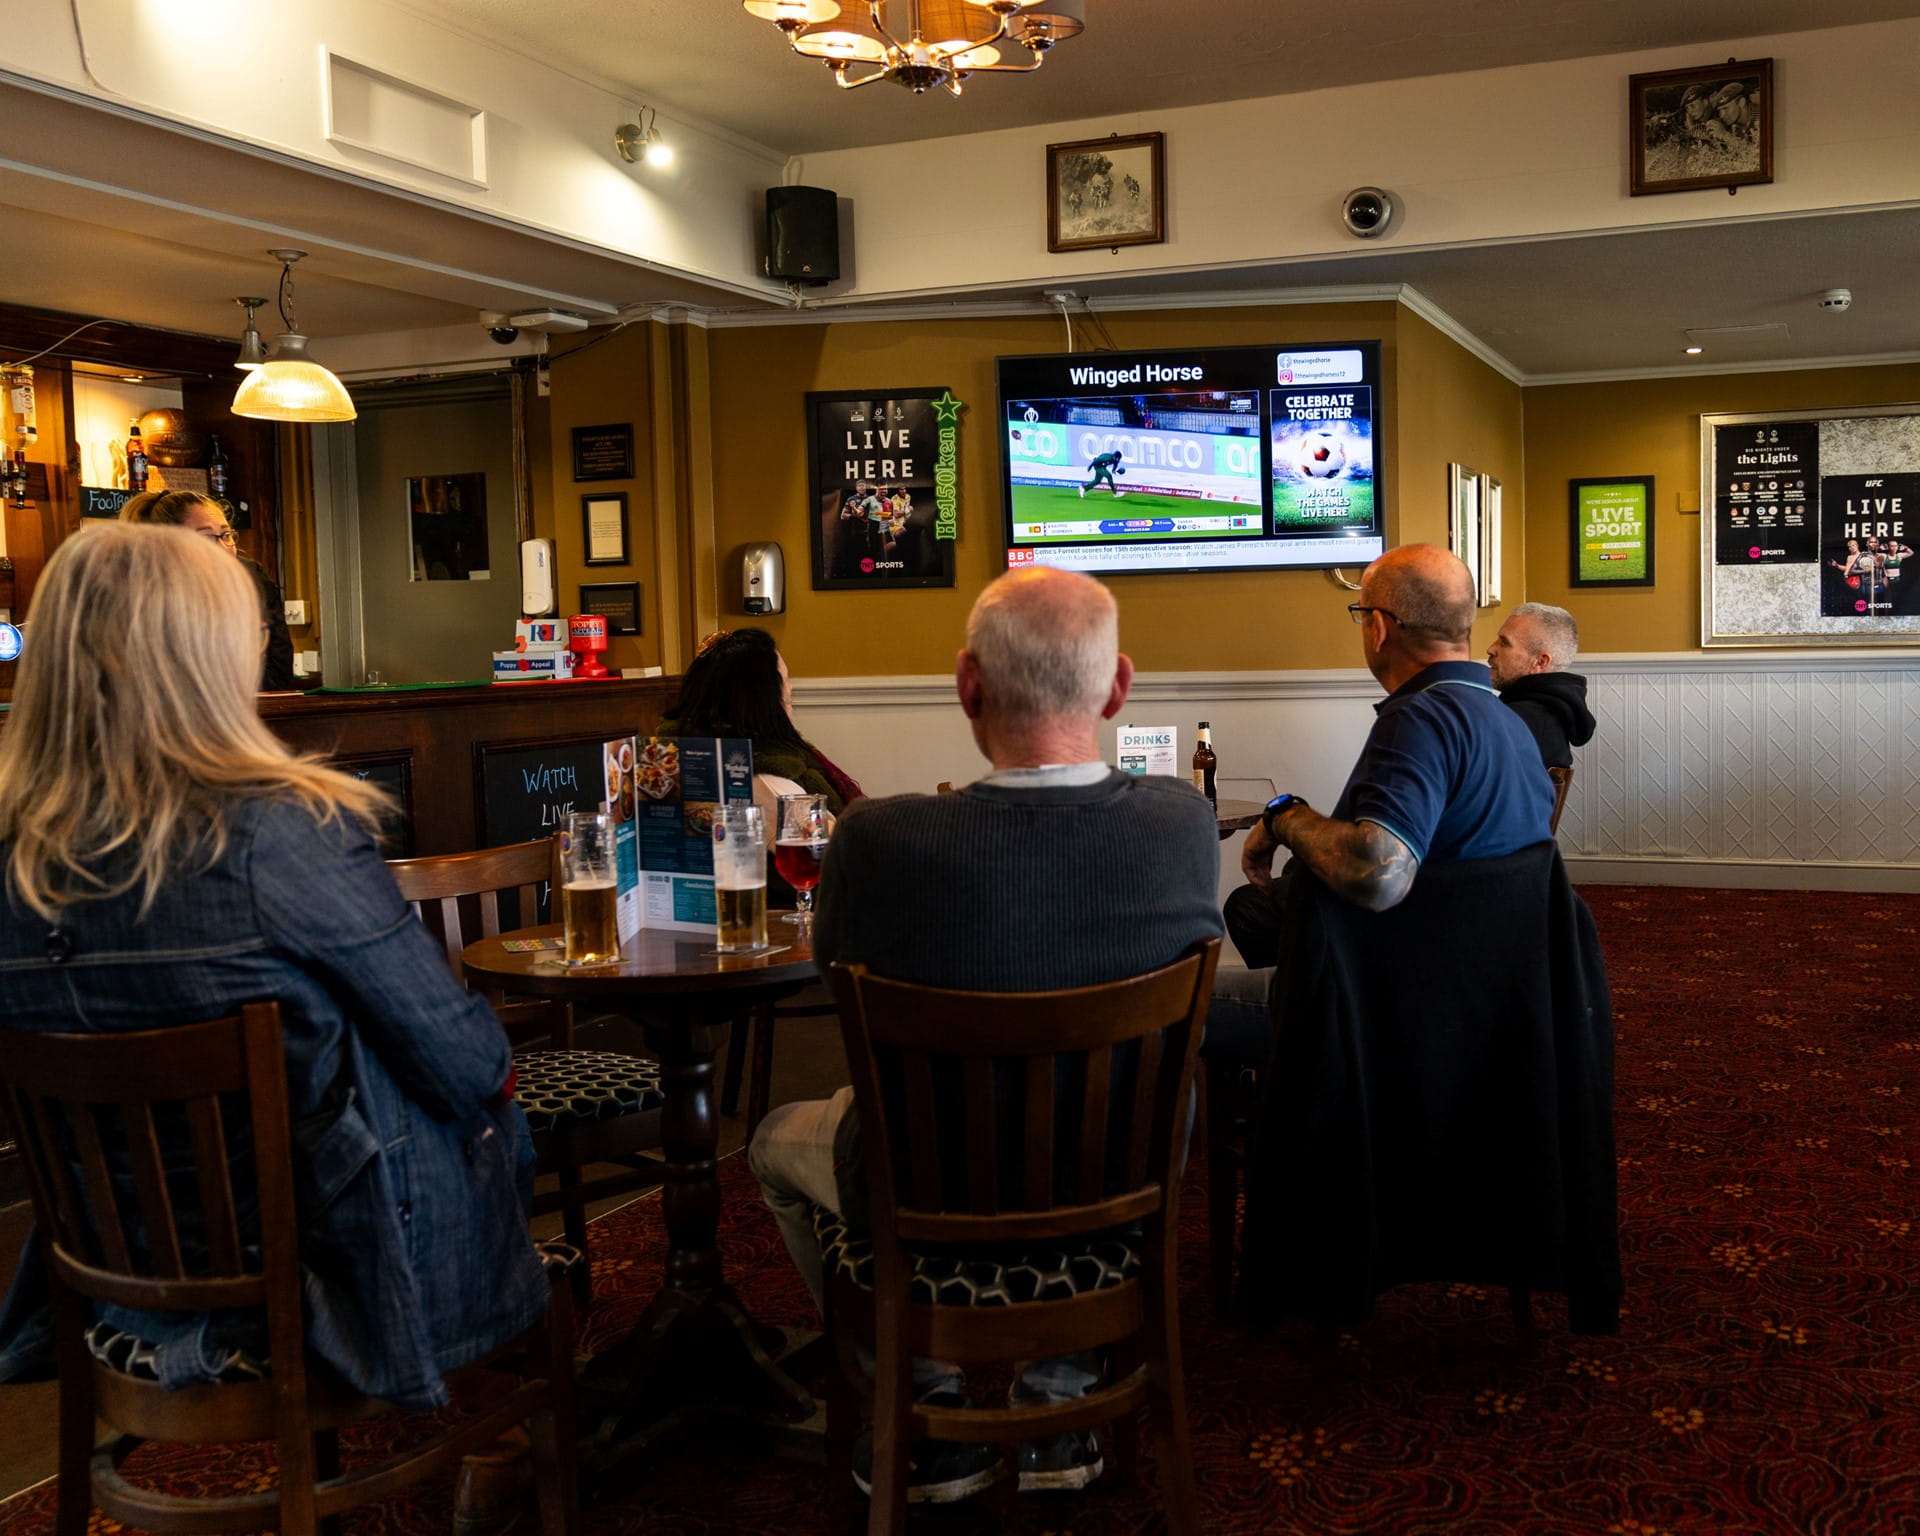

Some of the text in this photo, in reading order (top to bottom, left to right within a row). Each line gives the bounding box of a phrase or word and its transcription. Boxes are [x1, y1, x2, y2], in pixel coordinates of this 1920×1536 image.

[1070, 364, 1203, 388] Winged Horse
[1285, 394, 1354, 408] CELEBRATE
[1288, 407, 1352, 421] TOGETHER
[846, 429, 911, 450] LIVE
[1737, 453, 1798, 464] the Lights
[845, 459, 914, 480] HERE
[1307, 488, 1343, 498] WATCH
[1297, 498, 1351, 508] THE GAMES
[1846, 498, 1902, 515] LIVE
[1301, 508, 1349, 518] LIVE HERE
[1592, 507, 1634, 523] LIVE
[1585, 522, 1642, 537] SPORT
[1844, 521, 1904, 538] HERE
[1008, 552, 1033, 561] BBC
[875, 561, 904, 569] SPORTS
[500, 661, 550, 670] Poppy Appeal
[1124, 734, 1171, 745] DRINKS
[522, 762, 578, 795] WATCH
